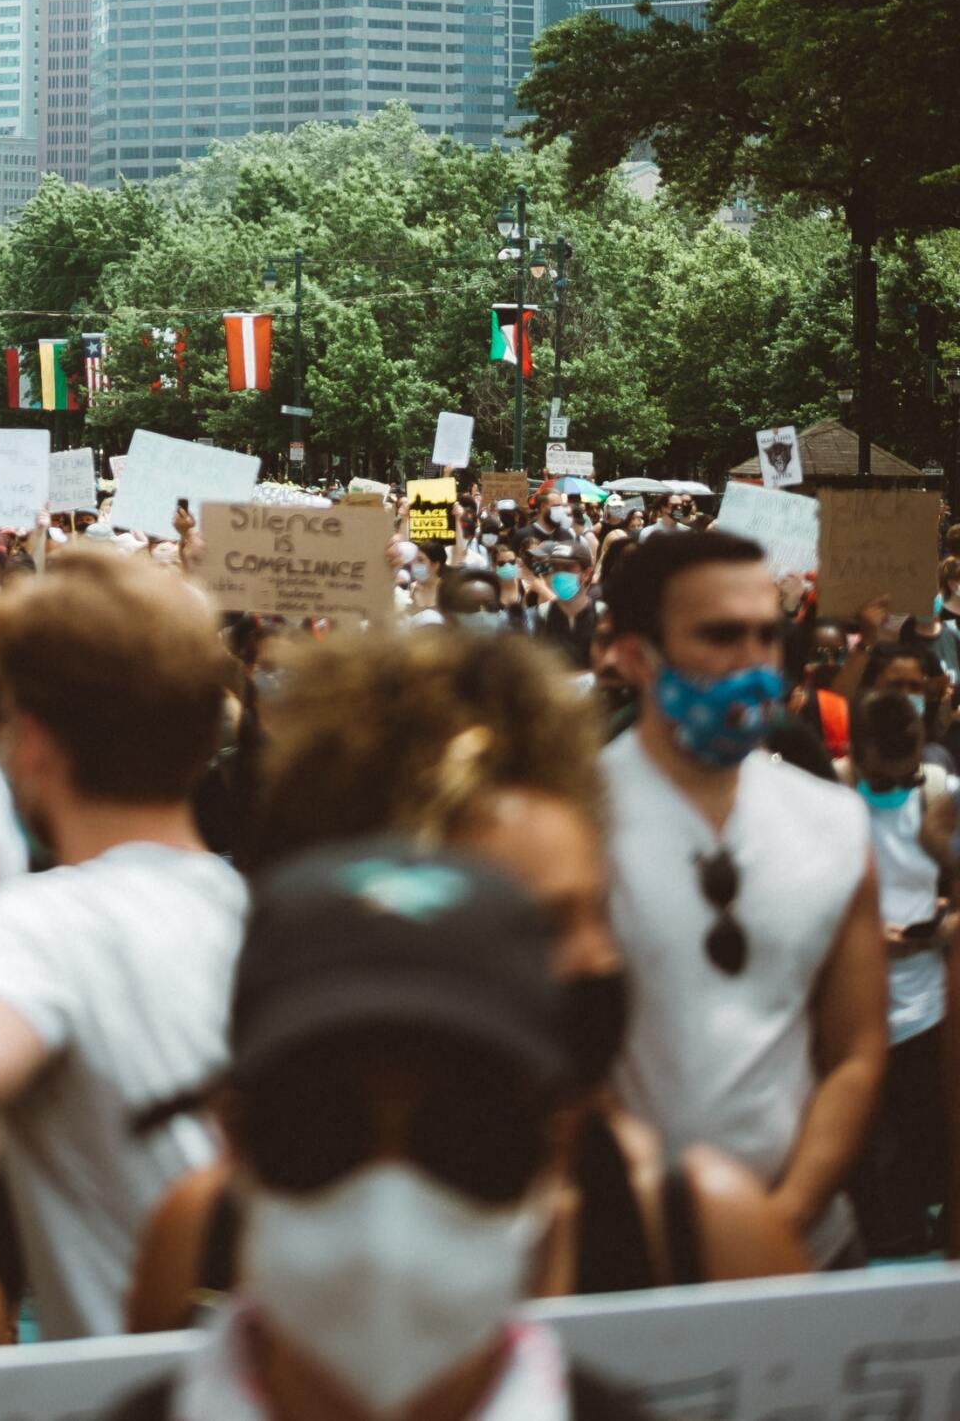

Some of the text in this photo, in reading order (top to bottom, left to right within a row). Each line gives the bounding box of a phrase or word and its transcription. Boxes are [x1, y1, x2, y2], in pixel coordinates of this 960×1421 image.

[410, 509, 447, 517] BLACK
[230, 505, 343, 533] Silence
[413, 519, 444, 527] LIVES
[410, 530, 456, 538] MATTER
[225, 551, 367, 578] COMPLIANCE
